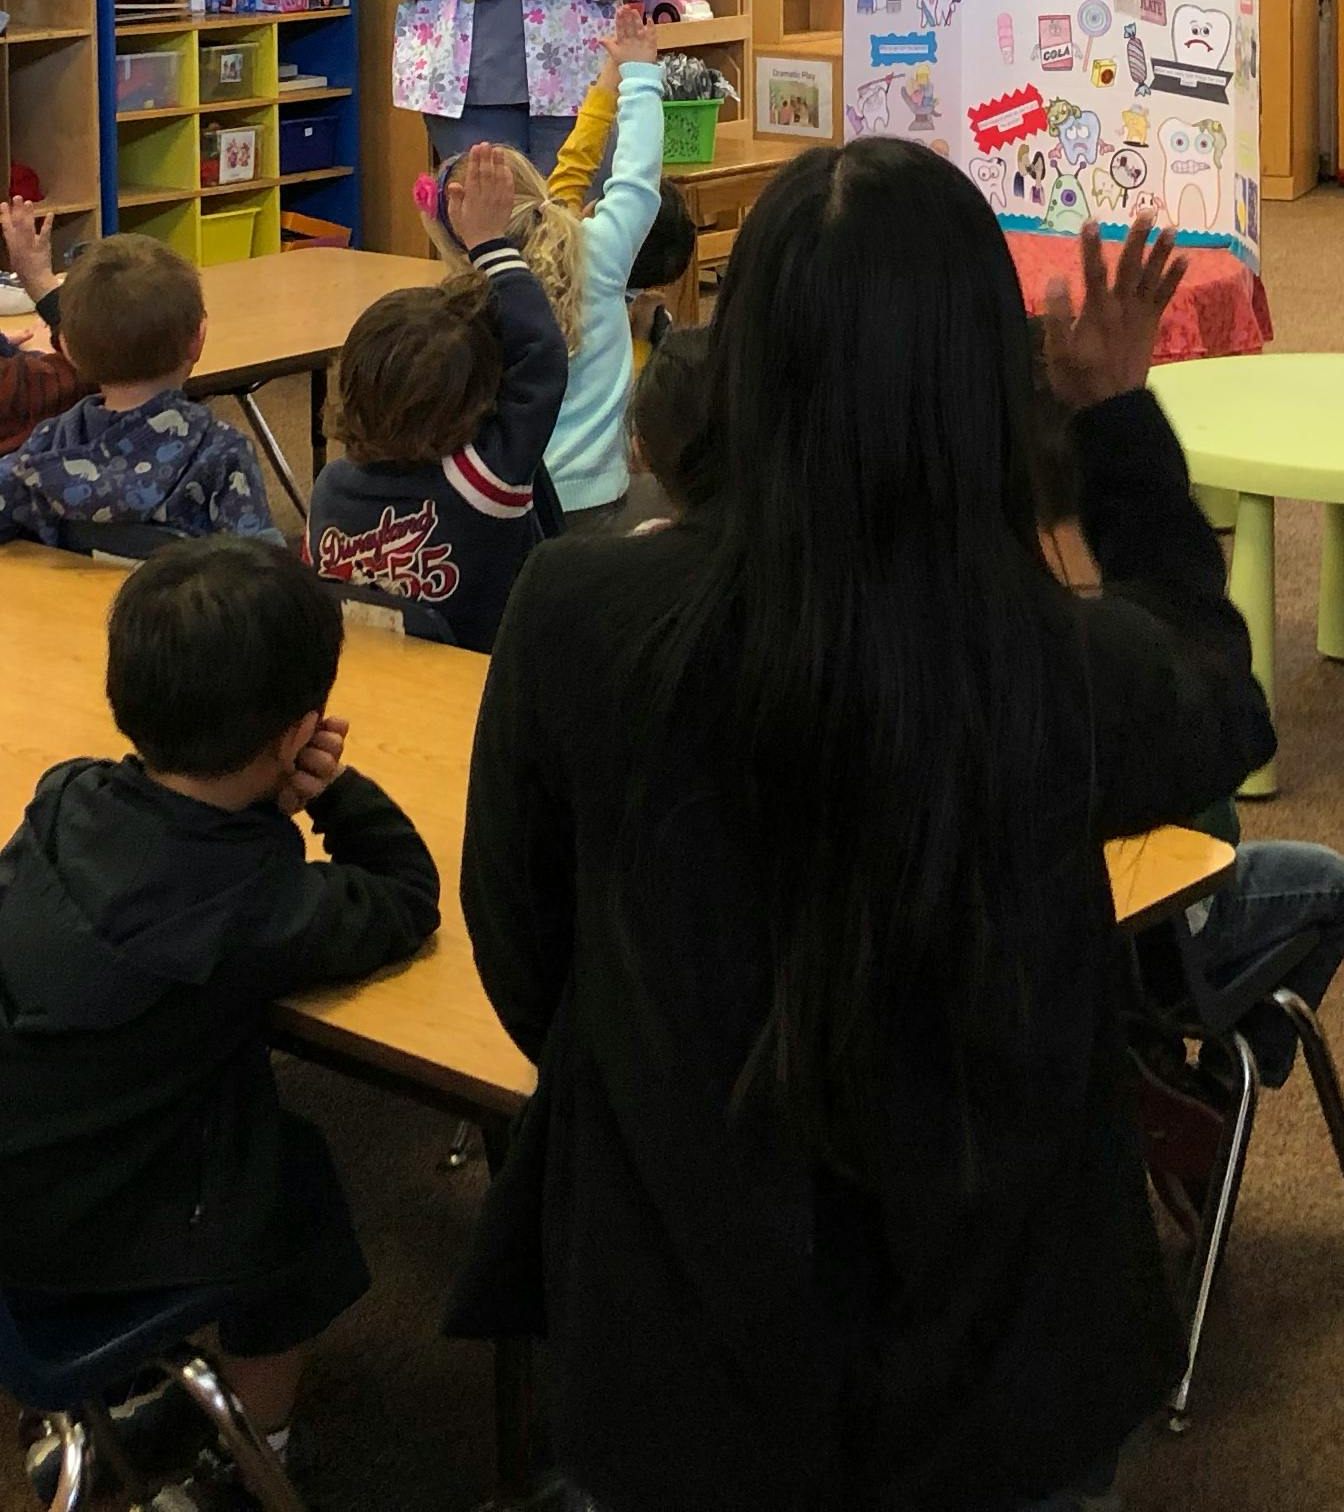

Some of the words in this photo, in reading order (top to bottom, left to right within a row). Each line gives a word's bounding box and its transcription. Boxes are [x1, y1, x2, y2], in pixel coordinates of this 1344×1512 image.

[1043, 45, 1071, 61] COLA
[801, 71, 816, 81] Play
[388, 543, 460, 602] 55
